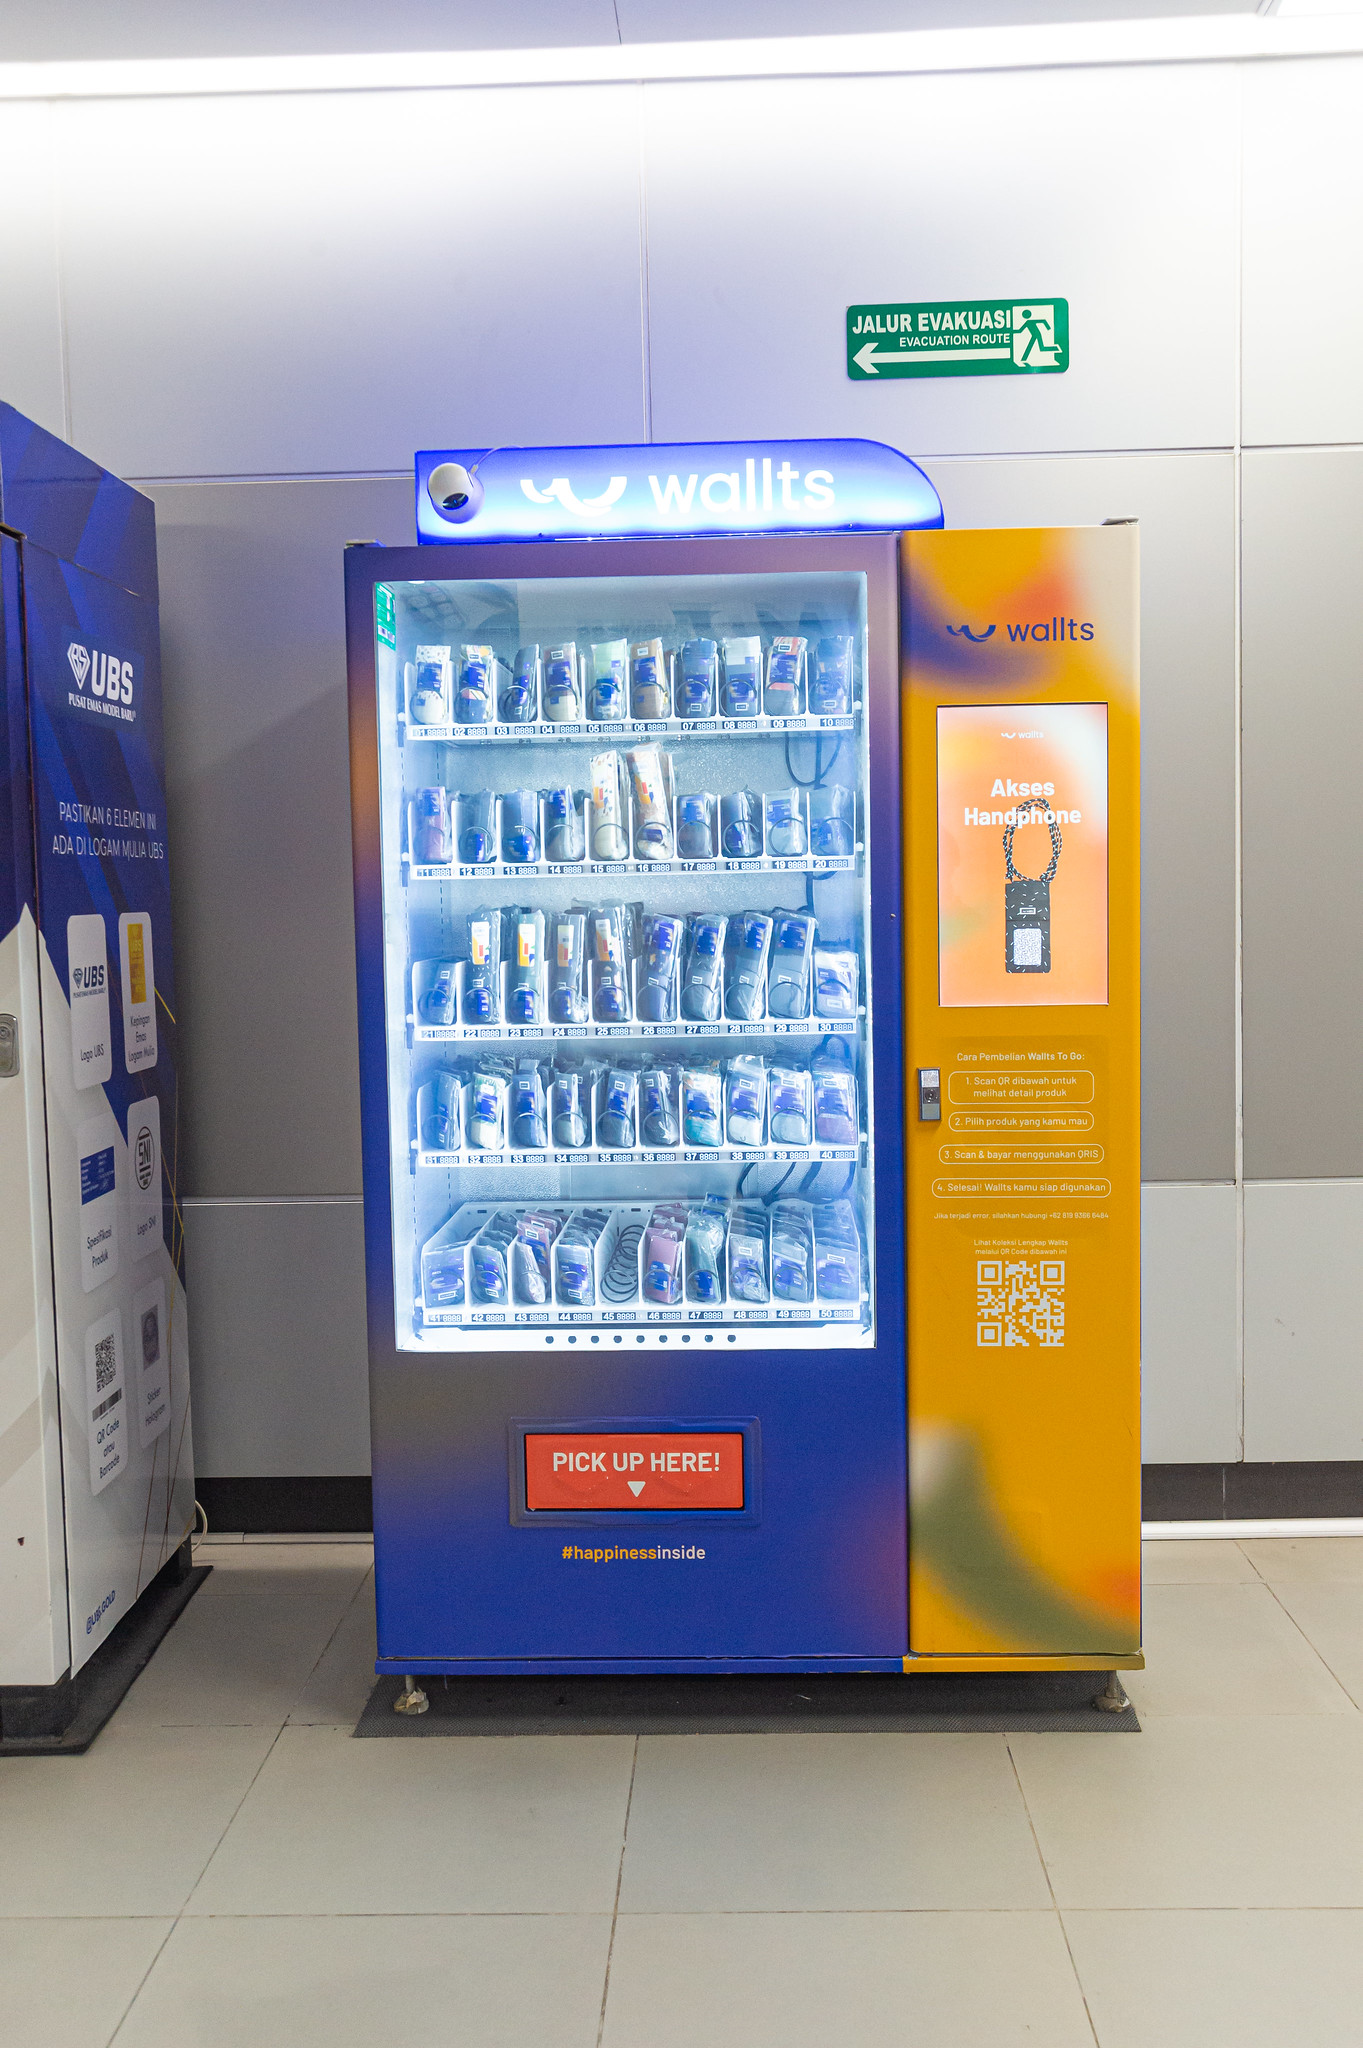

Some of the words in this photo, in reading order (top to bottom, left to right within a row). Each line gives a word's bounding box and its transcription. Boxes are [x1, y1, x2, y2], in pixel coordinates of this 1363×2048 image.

[852, 314, 912, 334] JALUR
[918, 310, 1011, 332] EVAKUASI
[900, 334, 969, 348] EVACUATION
[973, 334, 1010, 344] ROUTE
[648, 458, 835, 514] wallts
[1007, 617, 1094, 642] wallts
[91, 650, 134, 705] UBS
[68, 692, 87, 710] PUSAT
[86, 698, 102, 714] EMAS
[683, 722, 693, 730] 07
[773, 720, 784, 728] 09
[454, 728, 466, 736] 02
[542, 726, 552, 734] 04
[1018, 730, 1044, 739] wallts
[990, 779, 1055, 797] Akses
[59, 802, 104, 825] PASTIKAN
[106, 808, 111, 825] 6
[114, 809, 145, 829] ELEMEN
[147, 814, 156, 830] INI
[964, 808, 1082, 828] Handphone
[52, 835, 73, 855] ADA
[77, 838, 86, 855] DI
[88, 838, 120, 857] LOGAM
[123, 841, 146, 860] MULIA
[148, 842, 163, 859] UBS
[462, 868, 472, 876] 12
[84, 965, 104, 988] UBS
[554, 1028, 565, 1036] 24
[687, 1026, 698, 1034] 27
[776, 1024, 787, 1032] 29
[80, 1049, 93, 1062] Logo
[94, 1044, 104, 1057] UBS
[957, 1053, 977, 1061] Cara
[979, 1053, 1025, 1061] Pembelian
[1027, 1052, 1055, 1060] Wallts
[1057, 1052, 1068, 1060] To
[1070, 1052, 1084, 1060] Go:
[966, 1077, 972, 1085] 1.
[974, 1077, 996, 1085] Scan
[998, 1077, 1010, 1086] QR
[1013, 1077, 1049, 1085] dibawah
[1052, 1077, 1077, 1085] untuk
[974, 1089, 1006, 1097] melihat
[1009, 1089, 1034, 1097] detail
[1036, 1089, 1067, 1098] produk
[955, 1118, 963, 1126] 2.
[965, 1118, 984, 1126] Pilih
[986, 1118, 1017, 1127] produk
[1019, 1119, 1040, 1127] yang
[513, 1155, 524, 1163] 33
[556, 1154, 567, 1162] 34
[644, 1153, 654, 1161] 36
[732, 1152, 743, 1160] 38
[945, 1151, 952, 1159] 3.
[954, 1151, 976, 1159] Scan
[987, 1151, 1011, 1160] bayar
[1013, 1151, 1075, 1160] menggunakan
[1078, 1150, 1099, 1159] QRIS
[937, 1184, 945, 1192] 4.
[948, 1184, 982, 1192] Selesai!
[1014, 1183, 1037, 1191] kamu
[1040, 1183, 1058, 1193] siap
[1060, 1183, 1106, 1193] digunakan
[1018, 1239, 1046, 1247] Lengkap
[92, 1252, 108, 1269] Produk
[735, 1311, 746, 1319] 48
[97, 1427, 106, 1445] QR
[106, 1418, 119, 1436] Code
[99, 1453, 120, 1479] Barcode
[553, 1452, 607, 1472] PICK
[613, 1452, 644, 1472] UP
[651, 1452, 720, 1472] HERE!
[562, 1546, 706, 1563] #happinessinside
